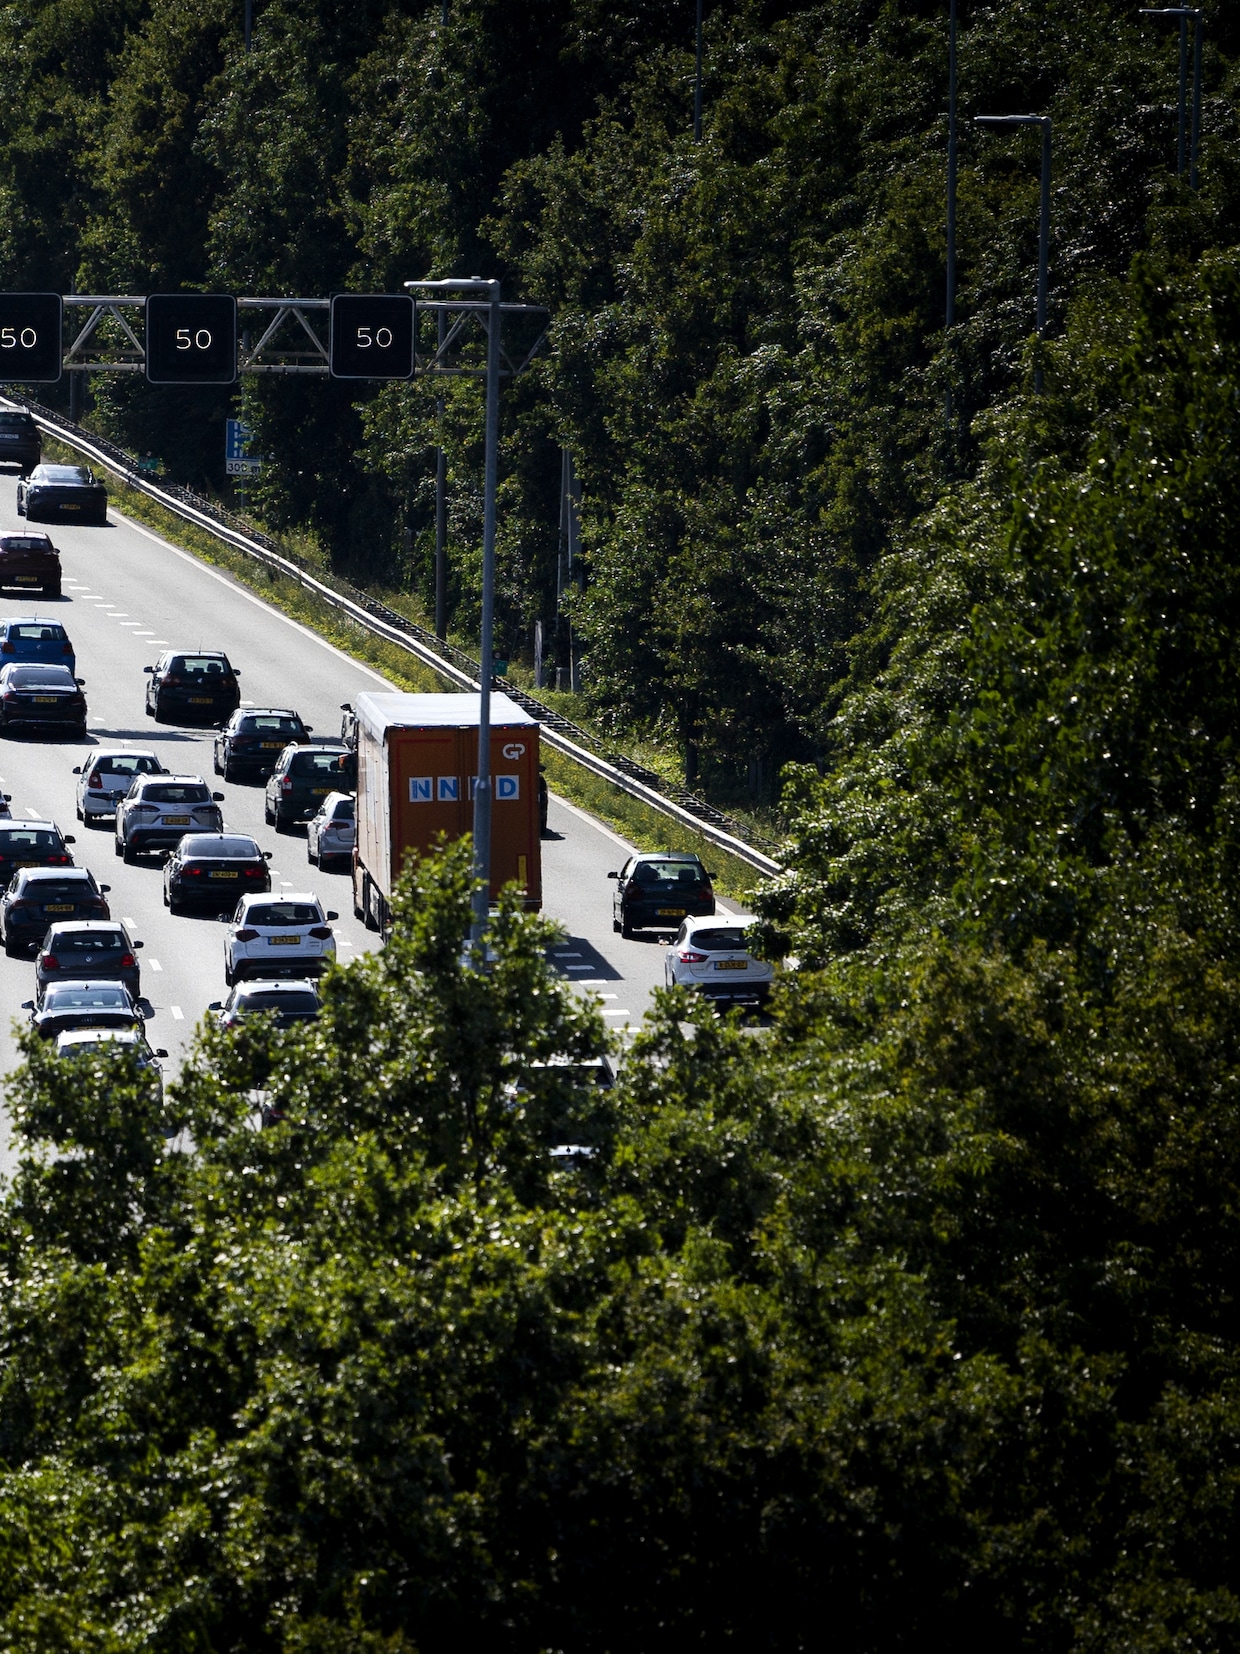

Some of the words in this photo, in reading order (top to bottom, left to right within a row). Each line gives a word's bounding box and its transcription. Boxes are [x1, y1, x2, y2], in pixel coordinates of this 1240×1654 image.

[0, 327, 37, 348] 50
[175, 328, 212, 350] 50
[356, 327, 393, 348] 50
[411, 777, 517, 800] NND
